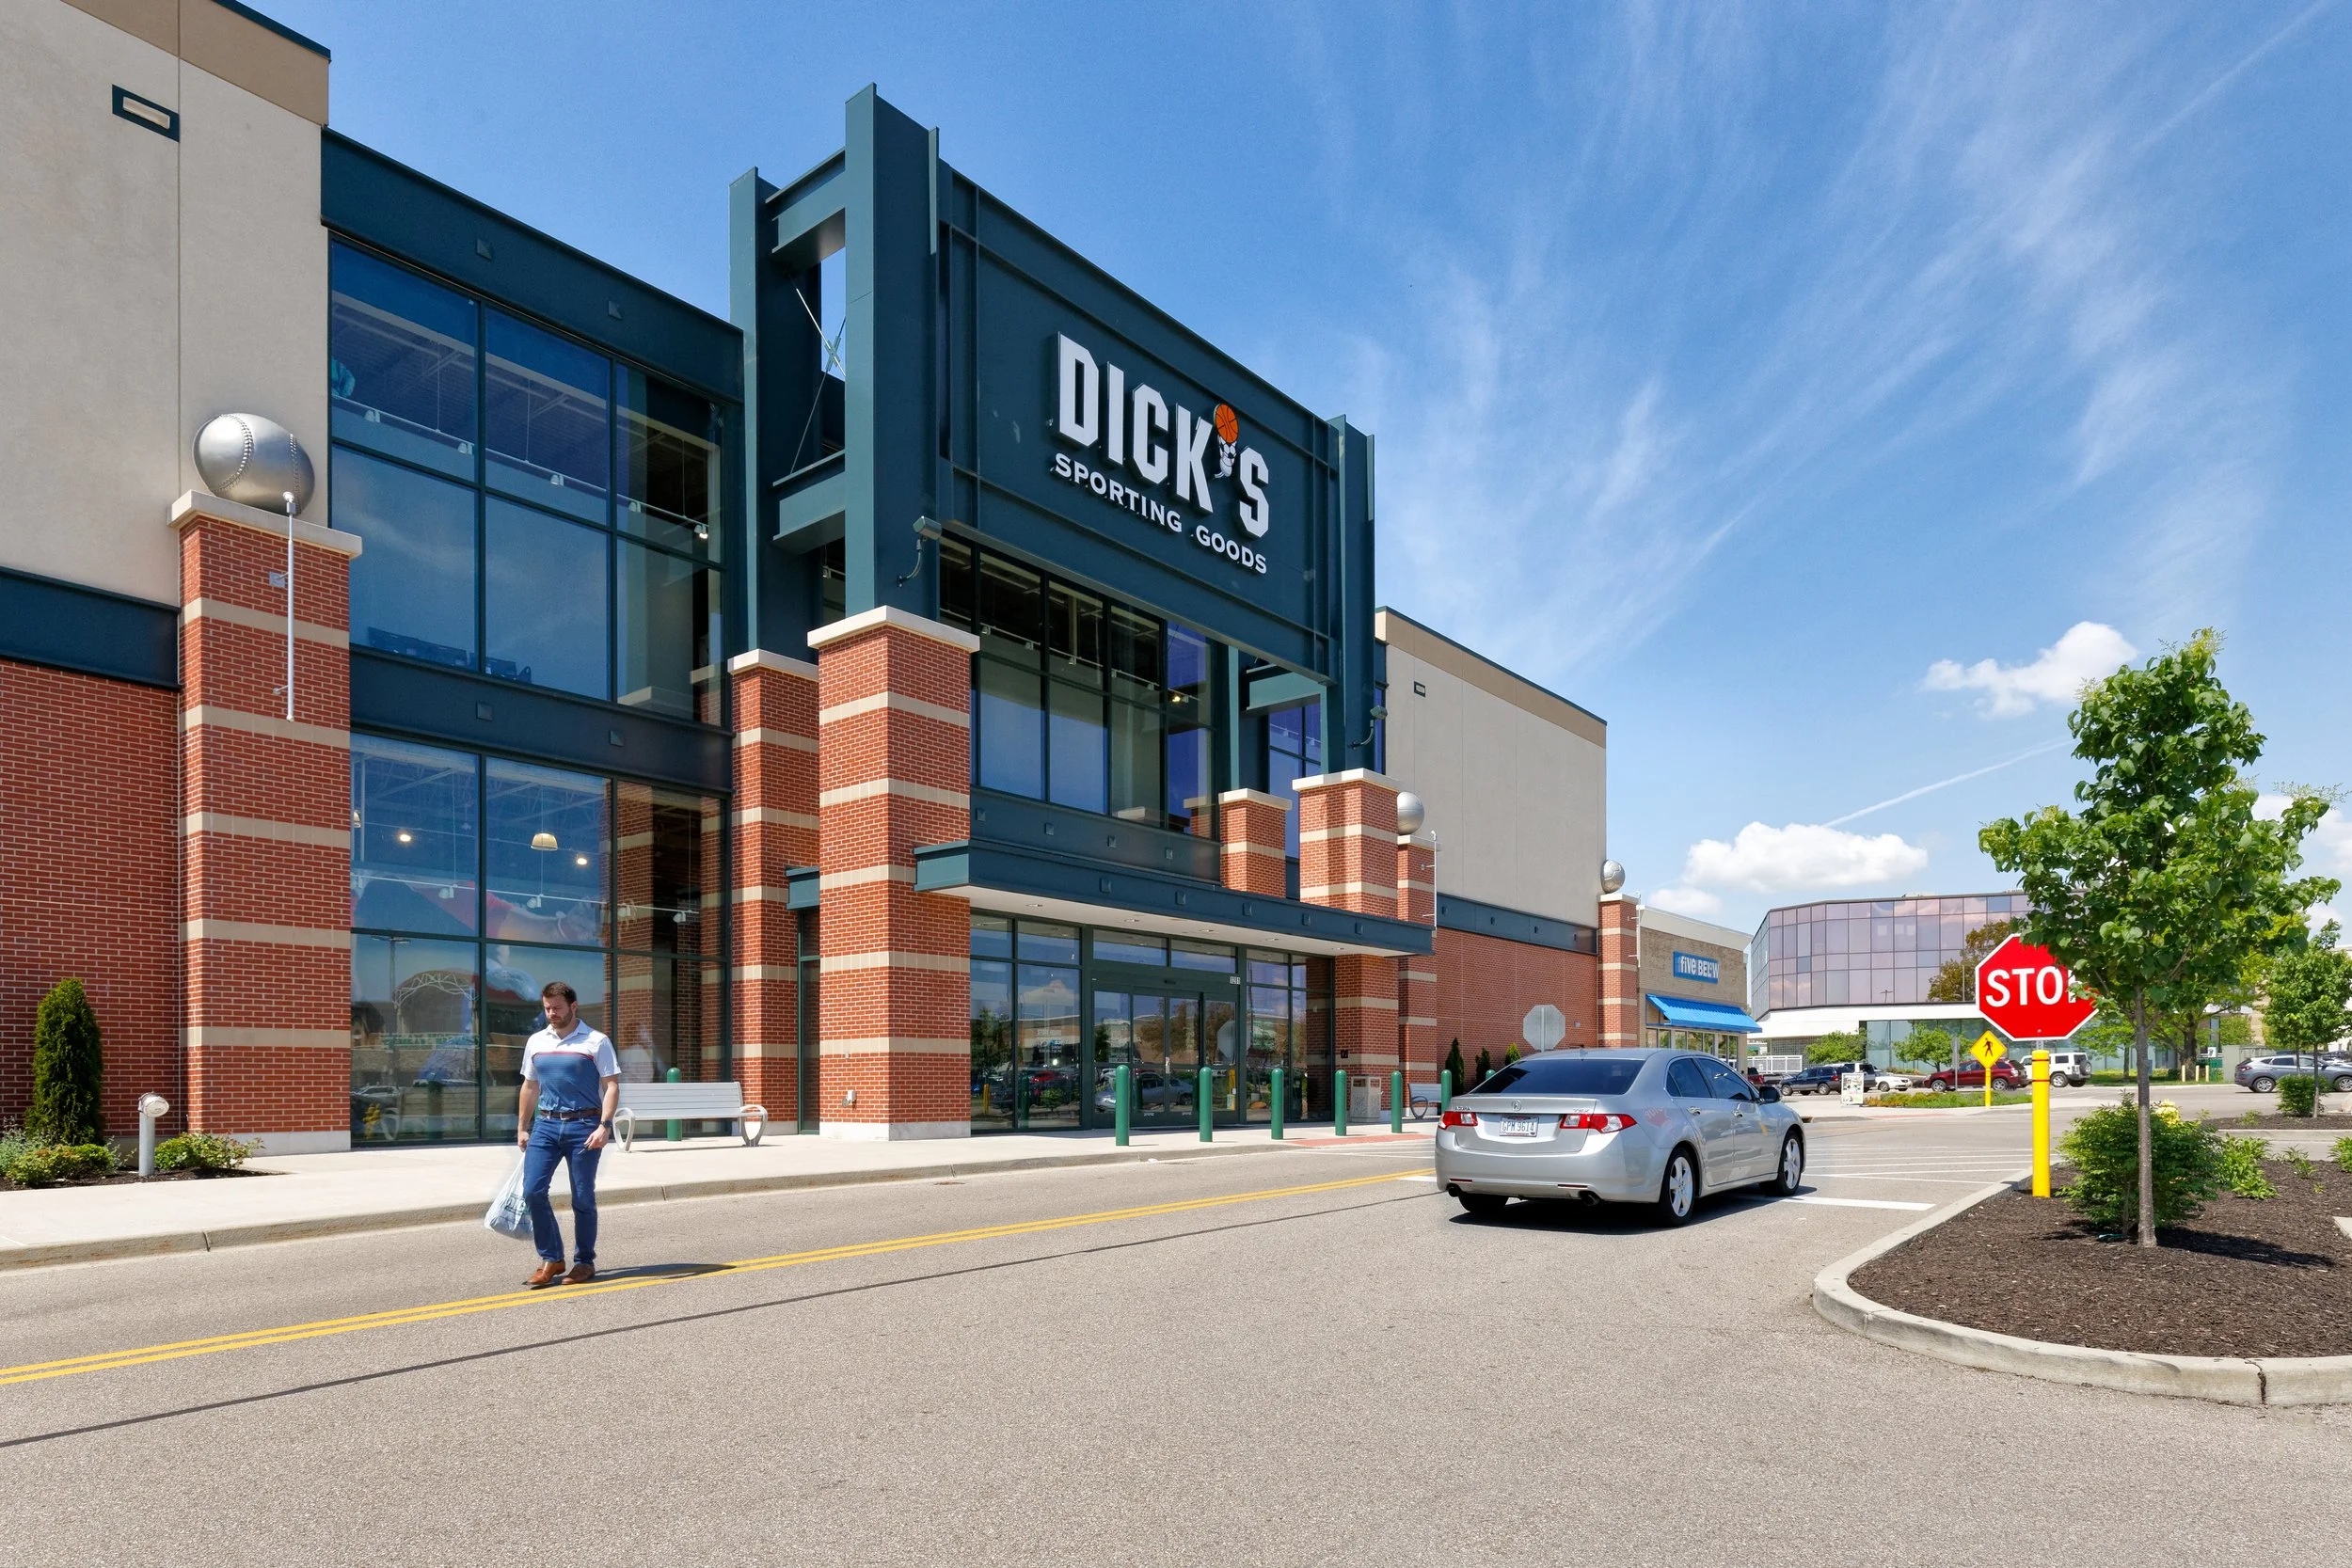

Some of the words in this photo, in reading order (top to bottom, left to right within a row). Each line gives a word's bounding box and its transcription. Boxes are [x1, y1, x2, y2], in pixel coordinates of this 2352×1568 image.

[1055, 452, 1183, 533] SPORTING
[1196, 525, 1267, 575] GOODS
[1058, 331, 1269, 538] DICK'S
